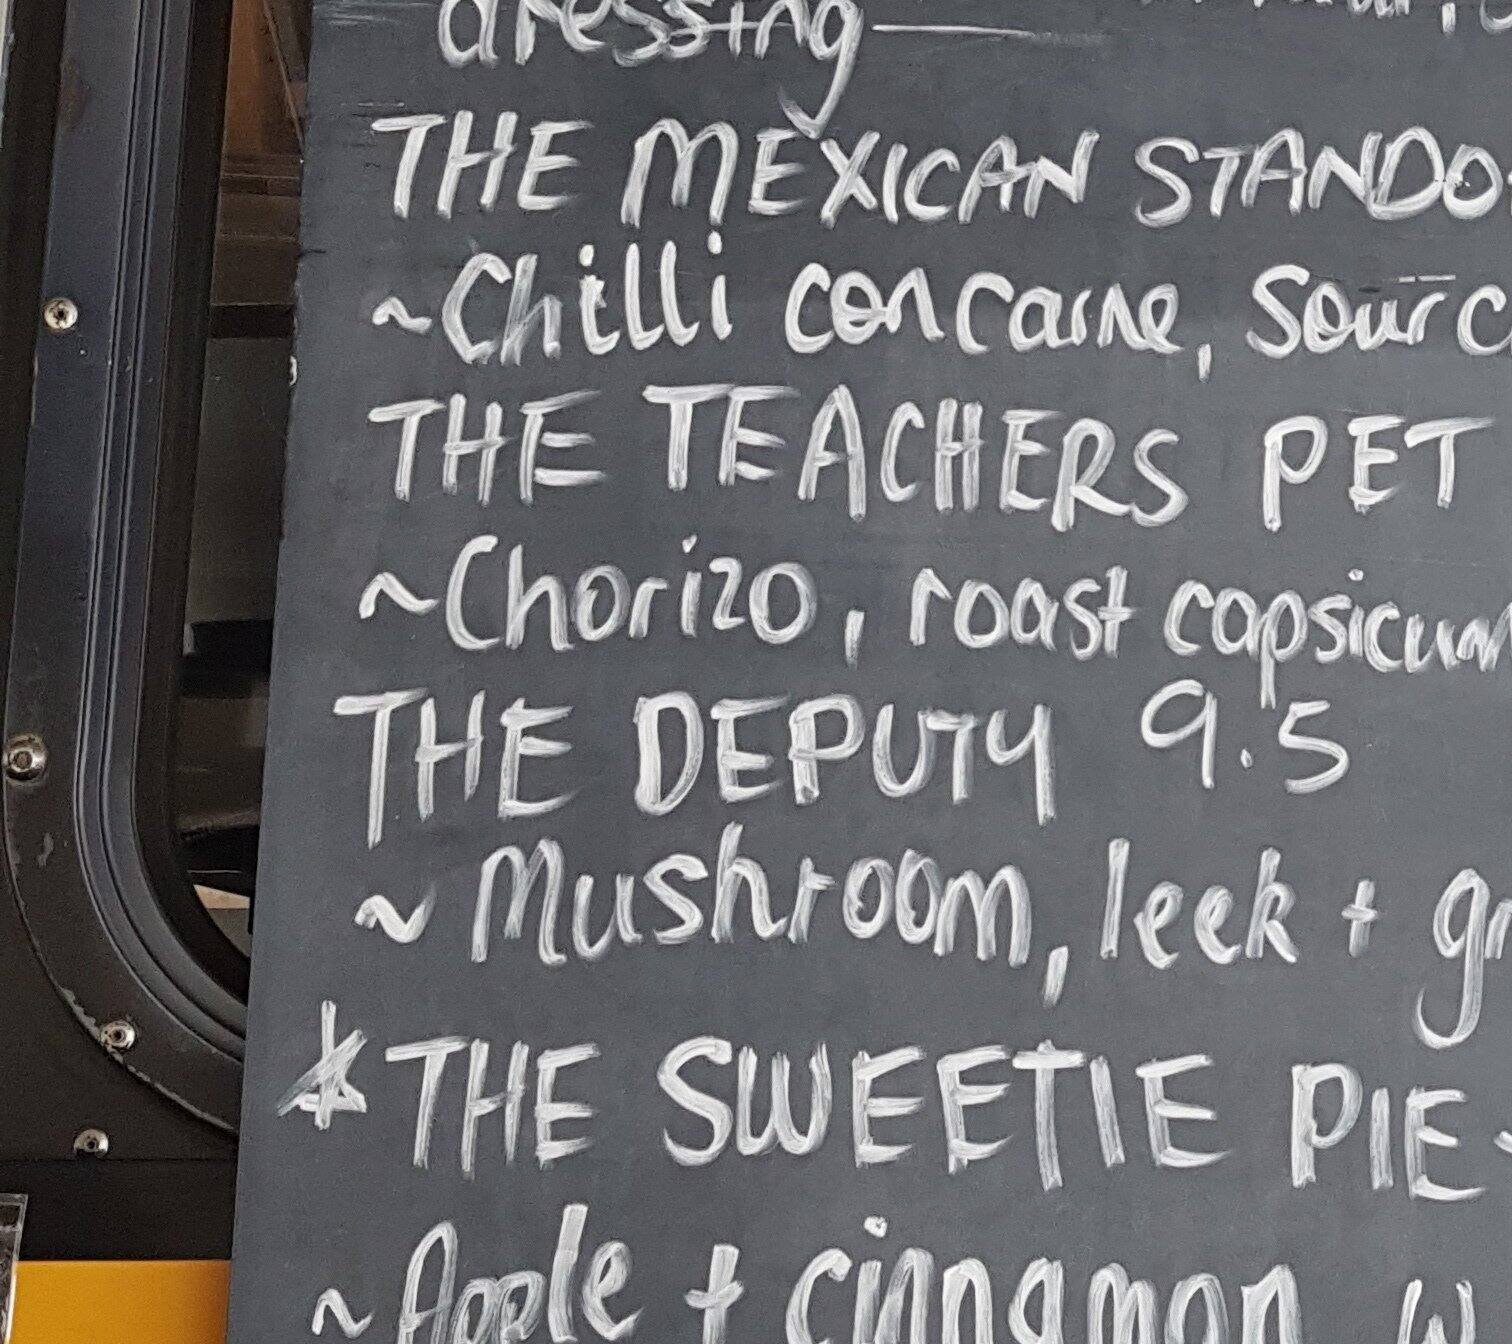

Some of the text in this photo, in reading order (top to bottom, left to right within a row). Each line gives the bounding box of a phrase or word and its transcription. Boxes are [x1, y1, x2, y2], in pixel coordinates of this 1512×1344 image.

[368, 107, 589, 222] THE
[618, 116, 1102, 230] MEXICAN
[439, 228, 735, 368] Chilli
[365, 389, 604, 507] THE
[640, 381, 1190, 534] TEACHERS
[1260, 412, 1492, 534] PET
[907, 564, 1136, 662] roast
[330, 677, 1351, 851] THE DEPUTY 9.5
[1098, 836, 1299, 972] leek
[383, 1034, 602, 1175] THE
[655, 1033, 1227, 1194] SWEETIE
[1288, 1061, 1485, 1203] PIE
